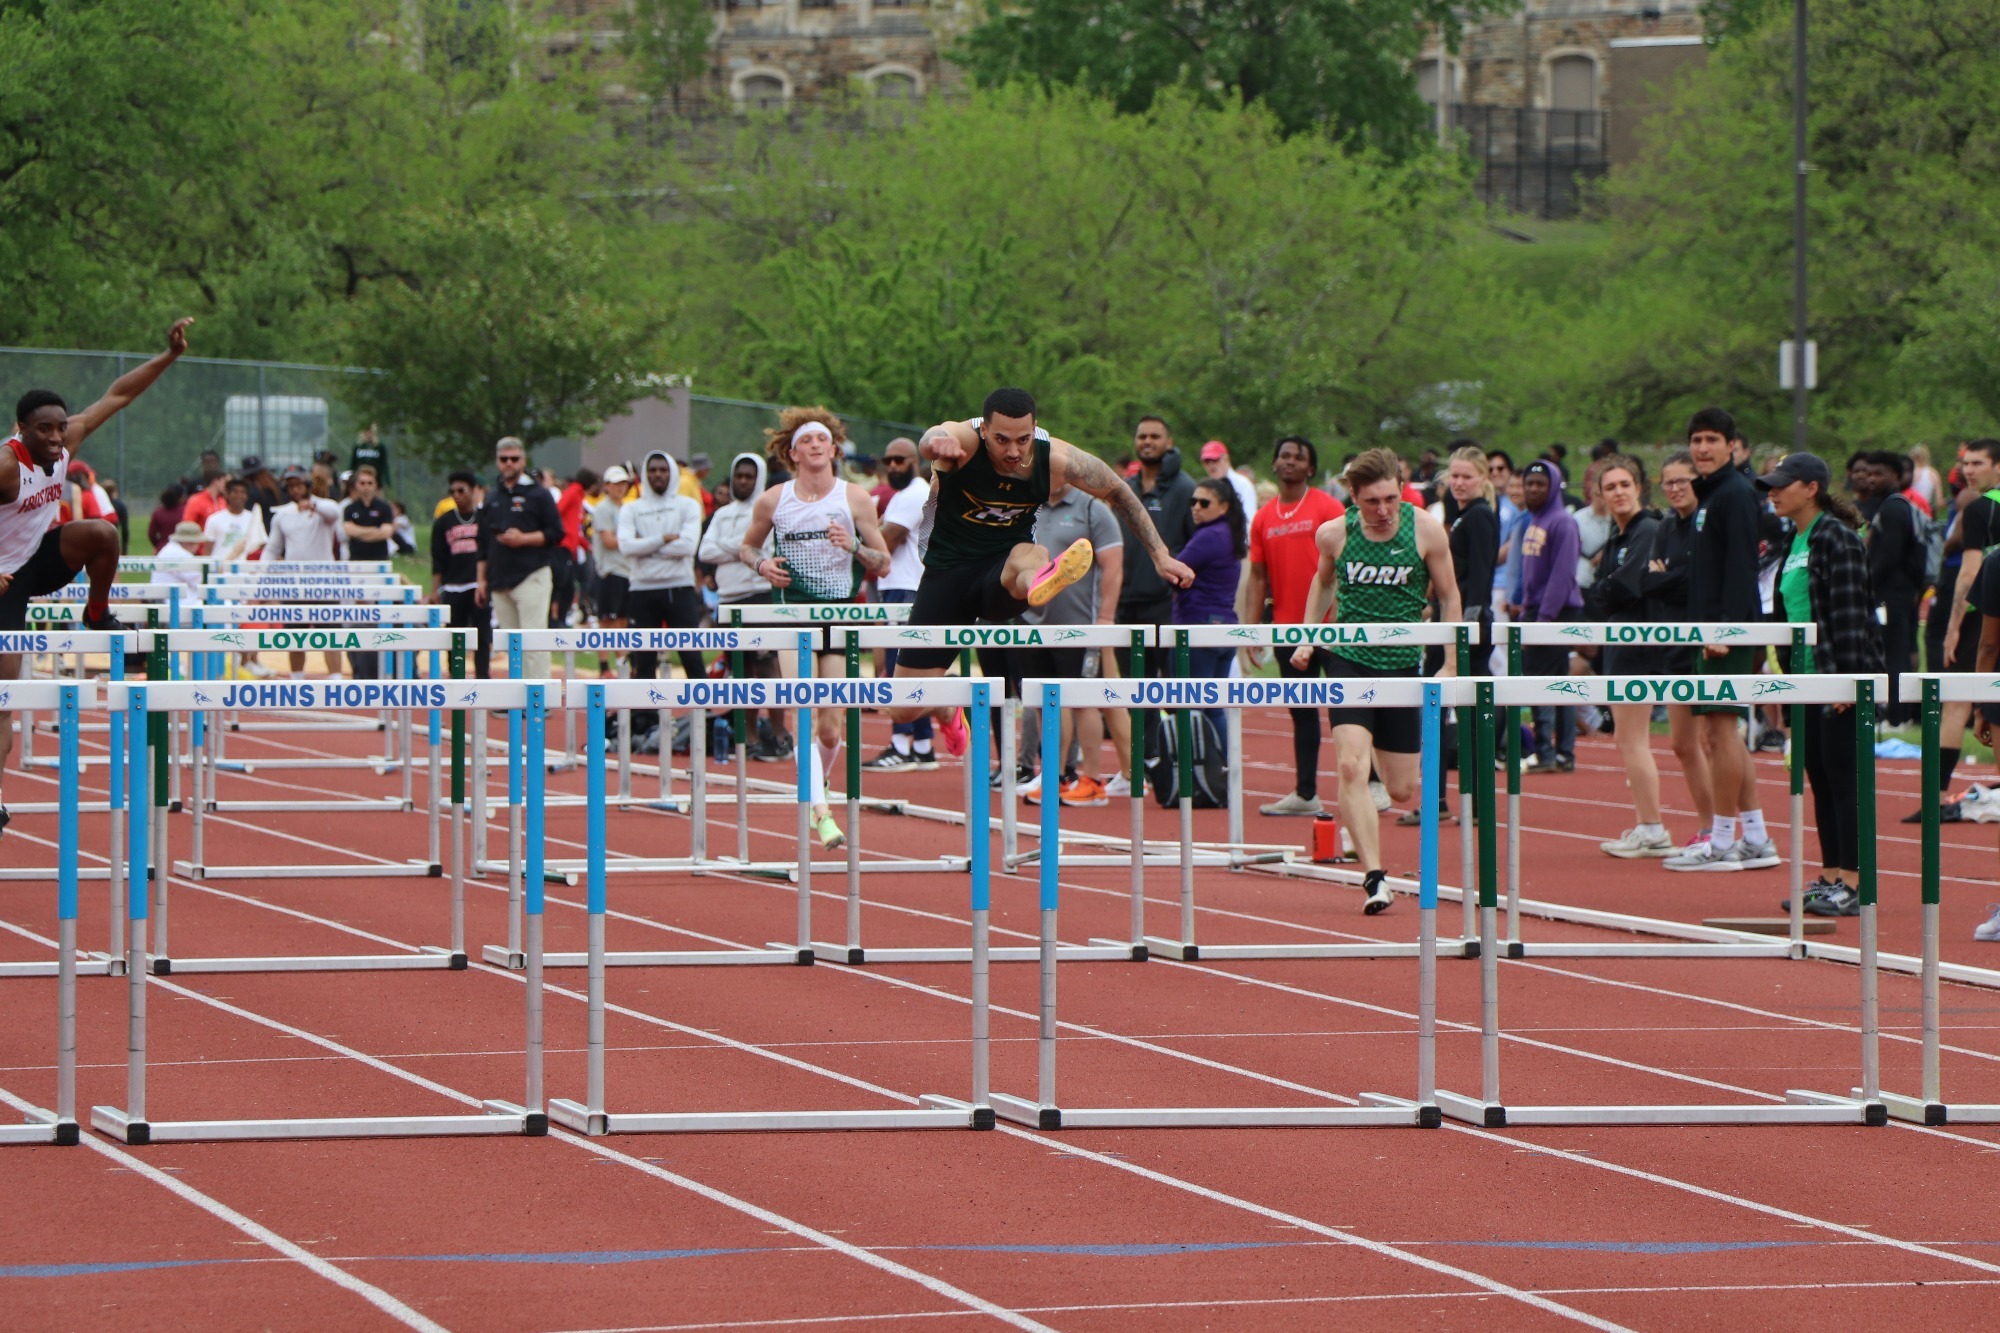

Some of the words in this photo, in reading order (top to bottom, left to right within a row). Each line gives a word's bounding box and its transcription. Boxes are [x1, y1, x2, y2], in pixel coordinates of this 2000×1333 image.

[785, 531, 829, 541] HAGERSTO
[267, 564, 300, 572] JOHNS
[303, 564, 350, 572] HOPKINS
[1346, 561, 1414, 586] YORK
[257, 577, 296, 585] JOHNS
[299, 577, 351, 585] HOPKINS
[67, 587, 129, 598] HONS
[254, 588, 299, 598] JOHNS
[304, 588, 365, 598] HOPKINS
[27, 607, 73, 620] OLA
[248, 608, 303, 622] JOHNS
[309, 608, 381, 622] HOPKINS
[810, 607, 888, 620] LOYOLA
[259, 632, 361, 649] LOYOLA
[576, 632, 643, 649] JOHNS
[650, 631, 739, 649] HOPKINS
[945, 629, 1043, 645] LOYOLA
[1272, 627, 1368, 643] LOYOLA
[1606, 626, 1704, 642] LOYOLA
[222, 684, 315, 707] JOHNS
[324, 684, 446, 707] HOPKINS
[677, 682, 766, 705] JOHNS
[775, 682, 893, 705] HOPKINS
[1131, 682, 1219, 705] JOHNS
[1228, 681, 1345, 704] HOPKINS
[1607, 680, 1738, 702] LOYOLA
